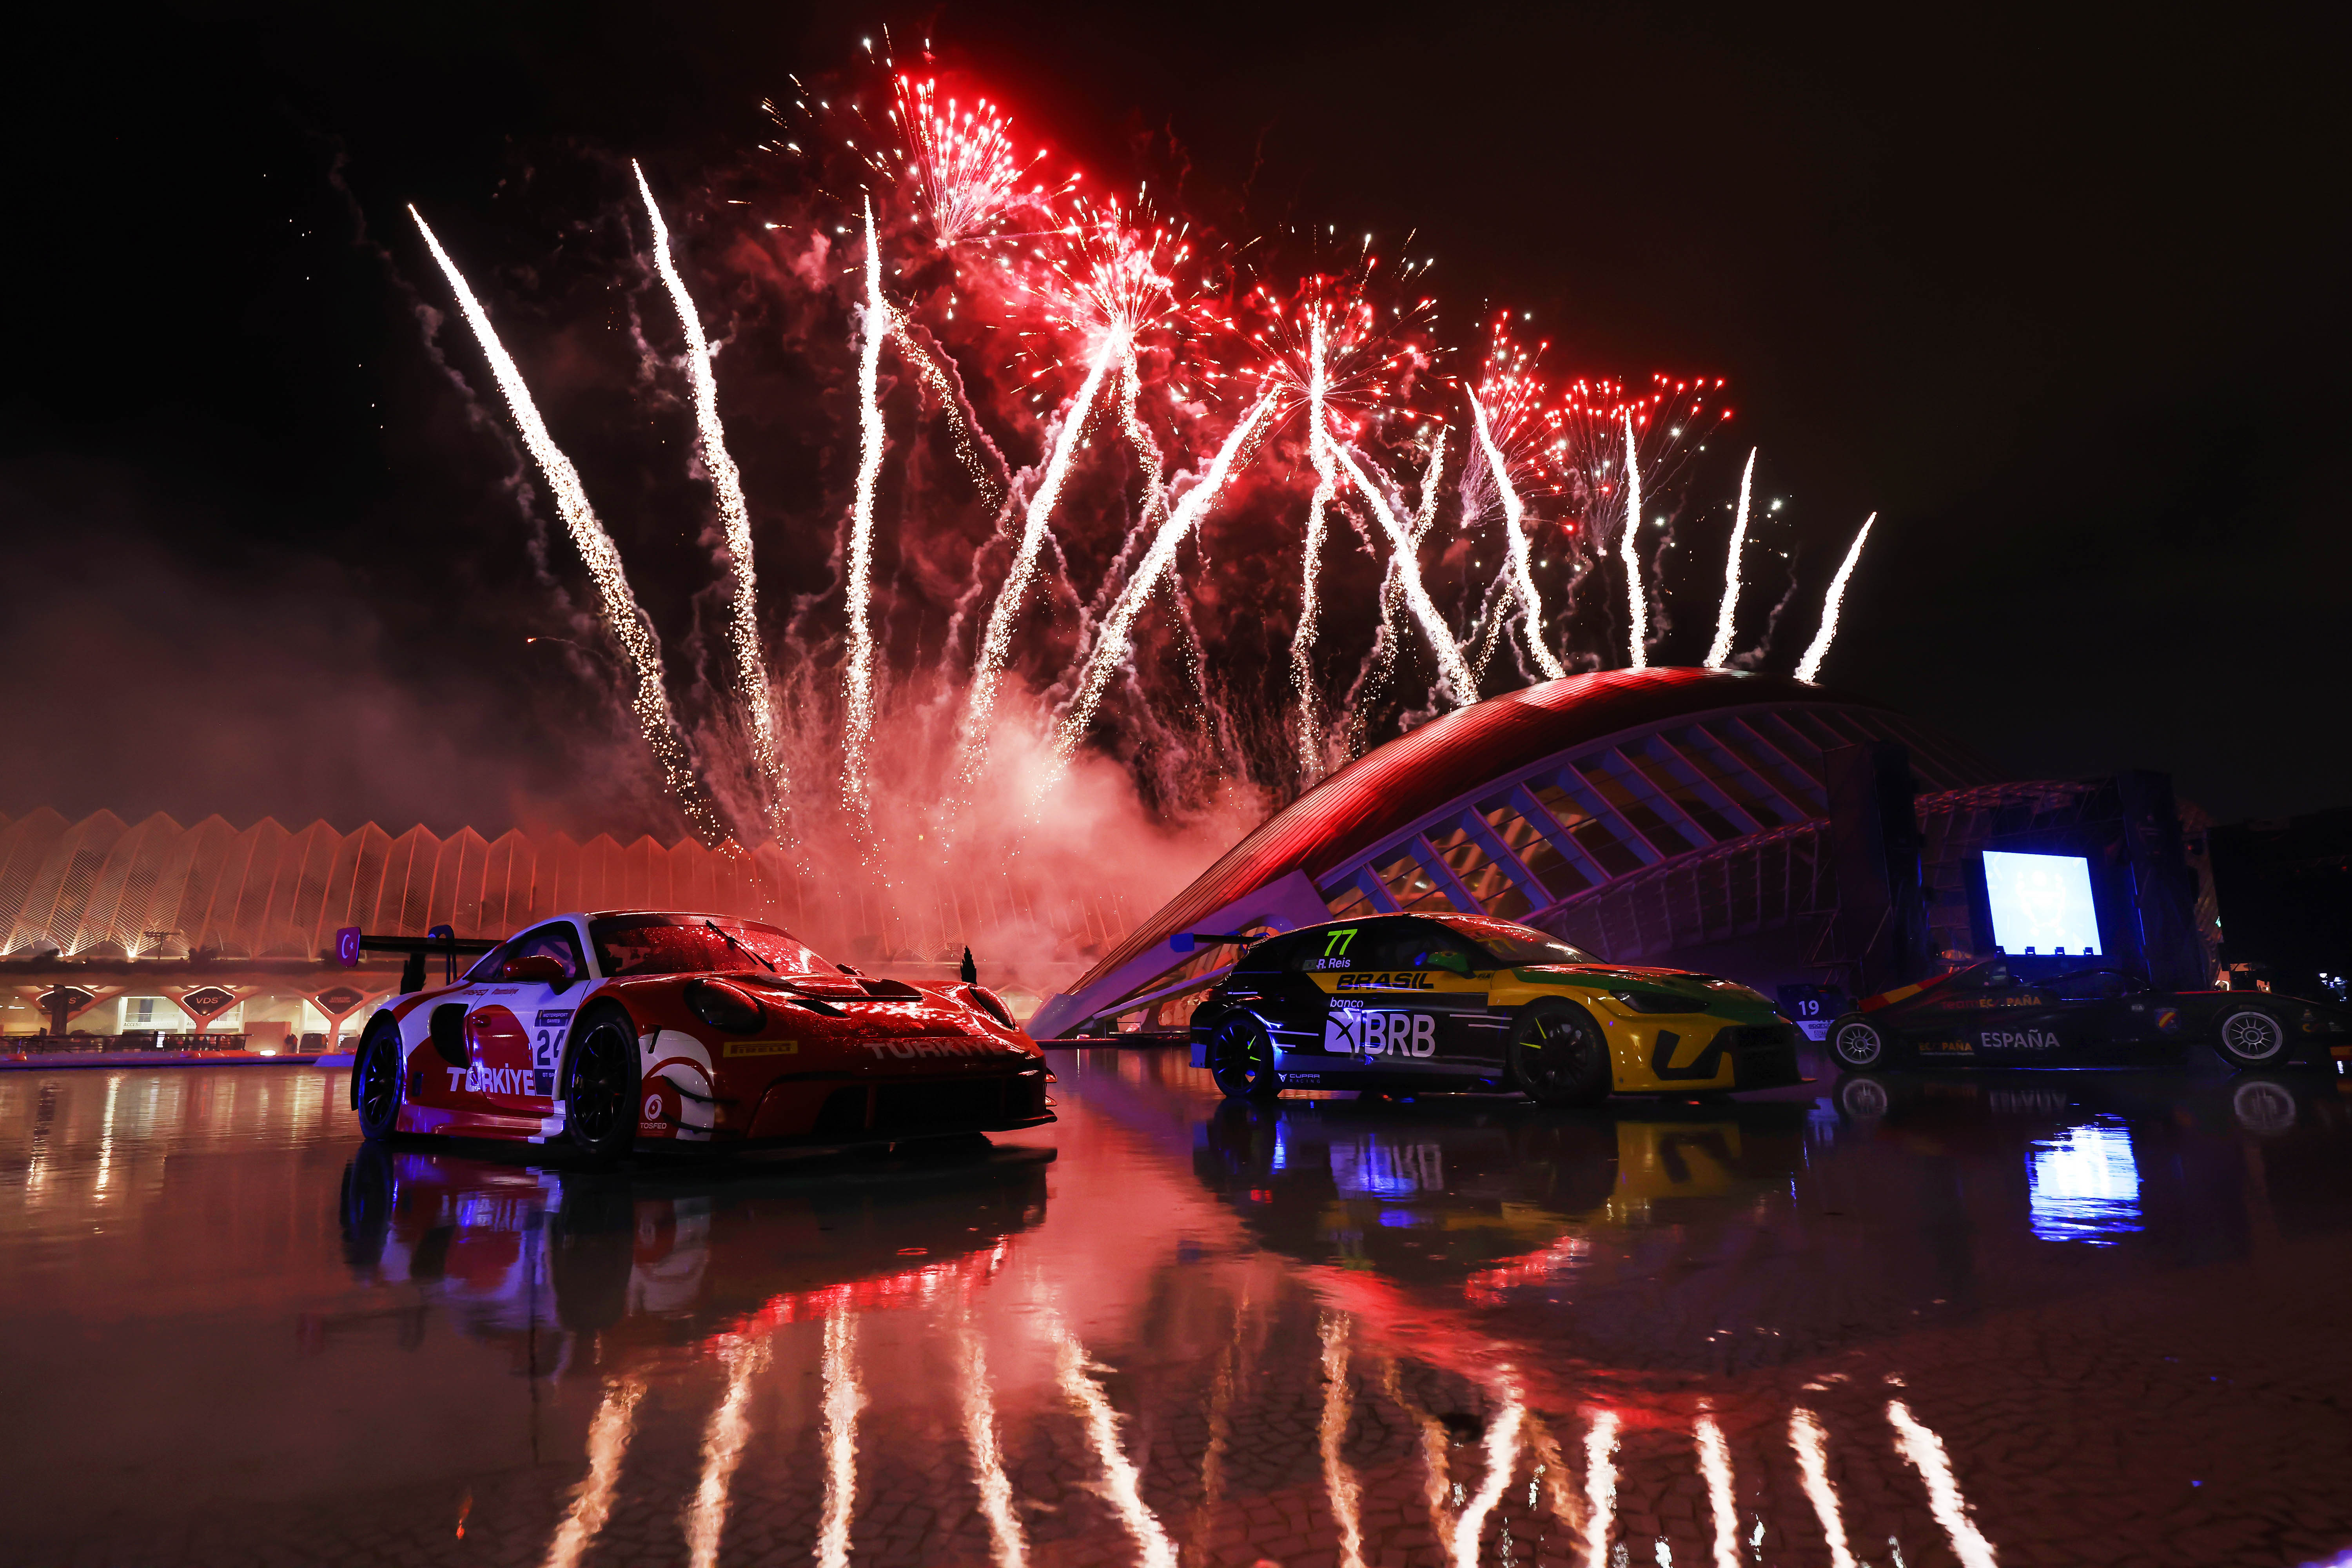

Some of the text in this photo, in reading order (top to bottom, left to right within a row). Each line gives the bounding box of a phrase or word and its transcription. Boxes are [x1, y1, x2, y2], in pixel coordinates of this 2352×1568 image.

[1324, 929, 1358, 956] 77
[1318, 957, 1350, 969] R. Reis
[1336, 973, 1434, 991] BRASIL
[1330, 997, 1364, 1008] banco
[1798, 1000, 1819, 1015] 19
[1364, 1013, 1436, 1058] BRB
[1981, 1029, 2060, 1048] ESPAÑA
[863, 1038, 1007, 1060] TÜRKİYE
[446, 1062, 536, 1097] TÜRKİYE
